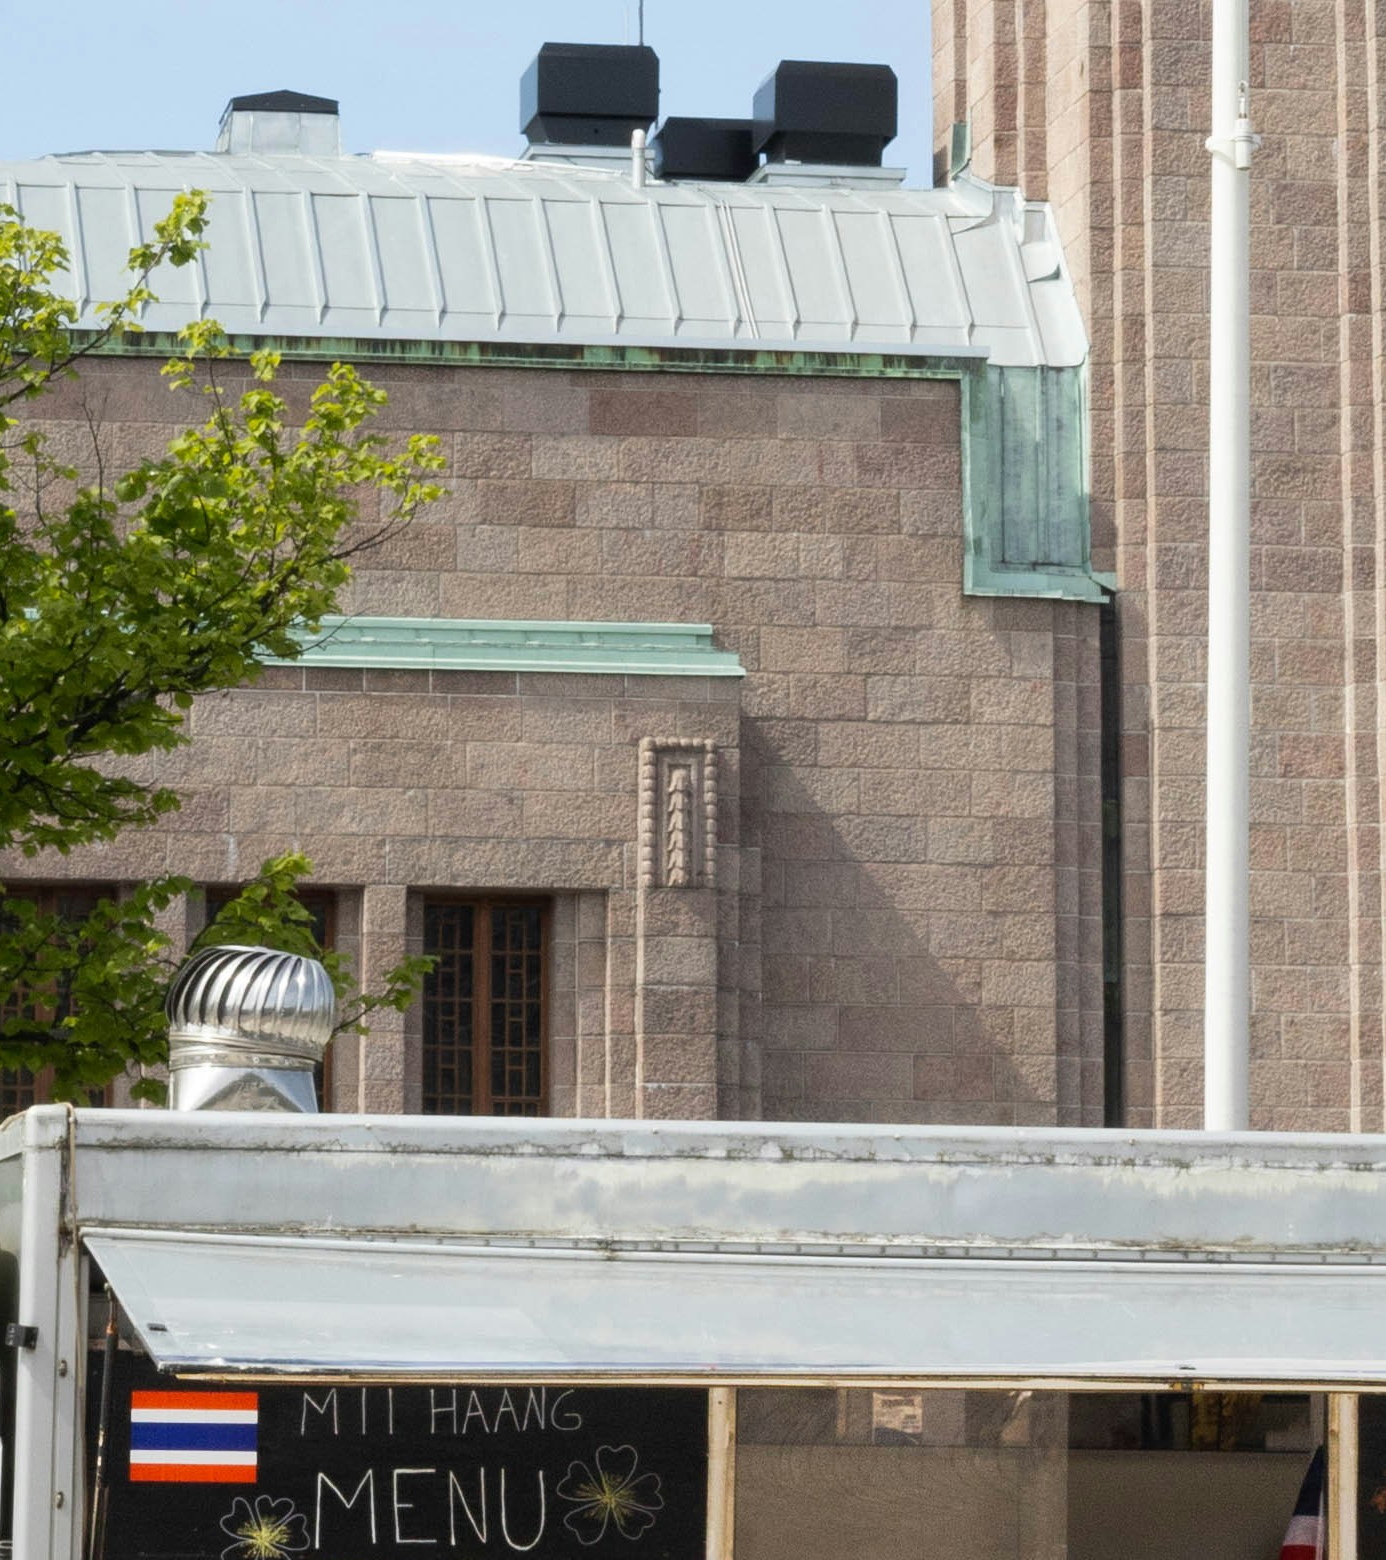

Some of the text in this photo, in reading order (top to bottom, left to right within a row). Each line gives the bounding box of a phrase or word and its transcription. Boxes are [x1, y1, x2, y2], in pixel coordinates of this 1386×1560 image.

[300, 1386, 583, 1436] MII HAANG
[313, 1465, 547, 1552] MENU
